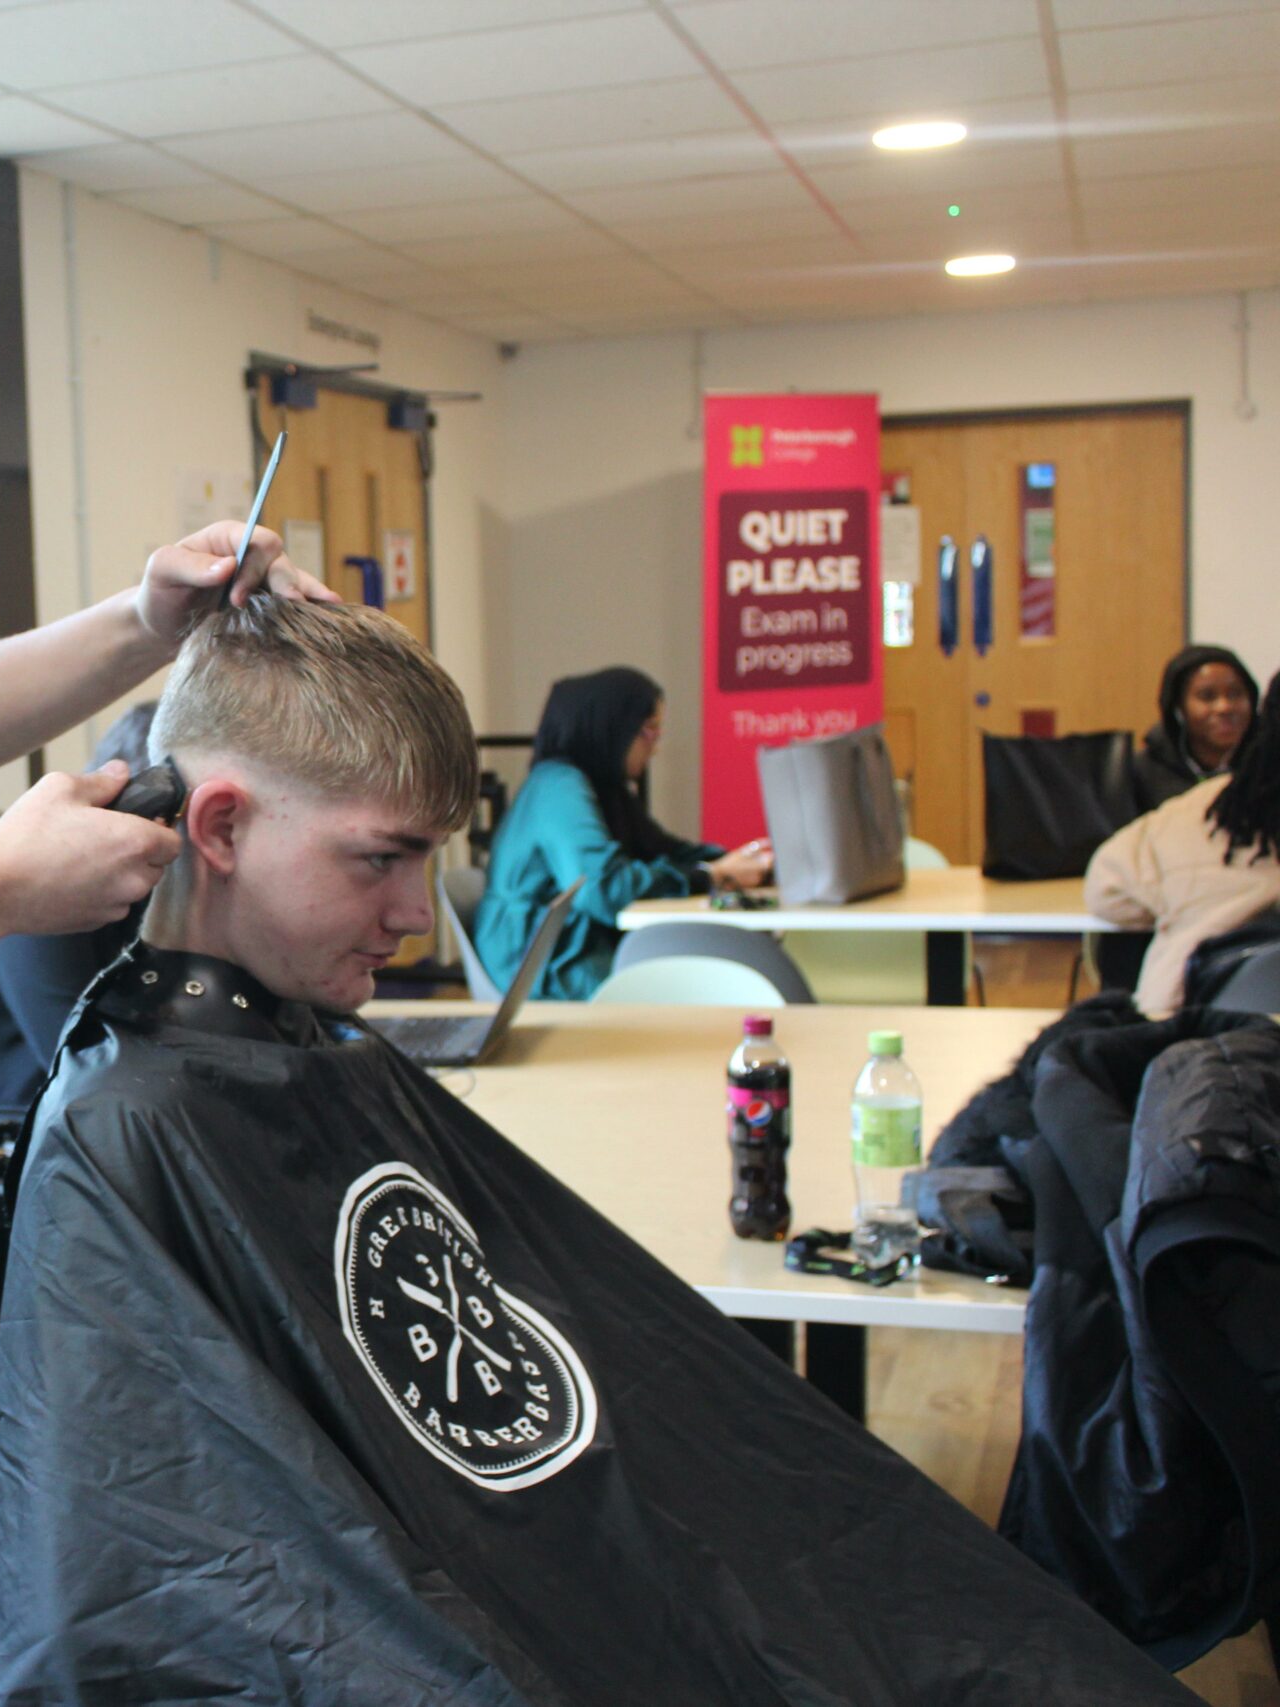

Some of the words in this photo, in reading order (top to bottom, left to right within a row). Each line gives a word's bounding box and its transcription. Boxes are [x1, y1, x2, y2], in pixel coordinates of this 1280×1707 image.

[739, 508, 849, 553] QUIET
[726, 555, 861, 596] PLEASE
[740, 605, 818, 638] Exam
[821, 601, 848, 632] in
[735, 640, 854, 678] progress
[731, 707, 810, 738] Thank
[813, 708, 857, 738] you
[403, 1381, 543, 1447] BARBER
